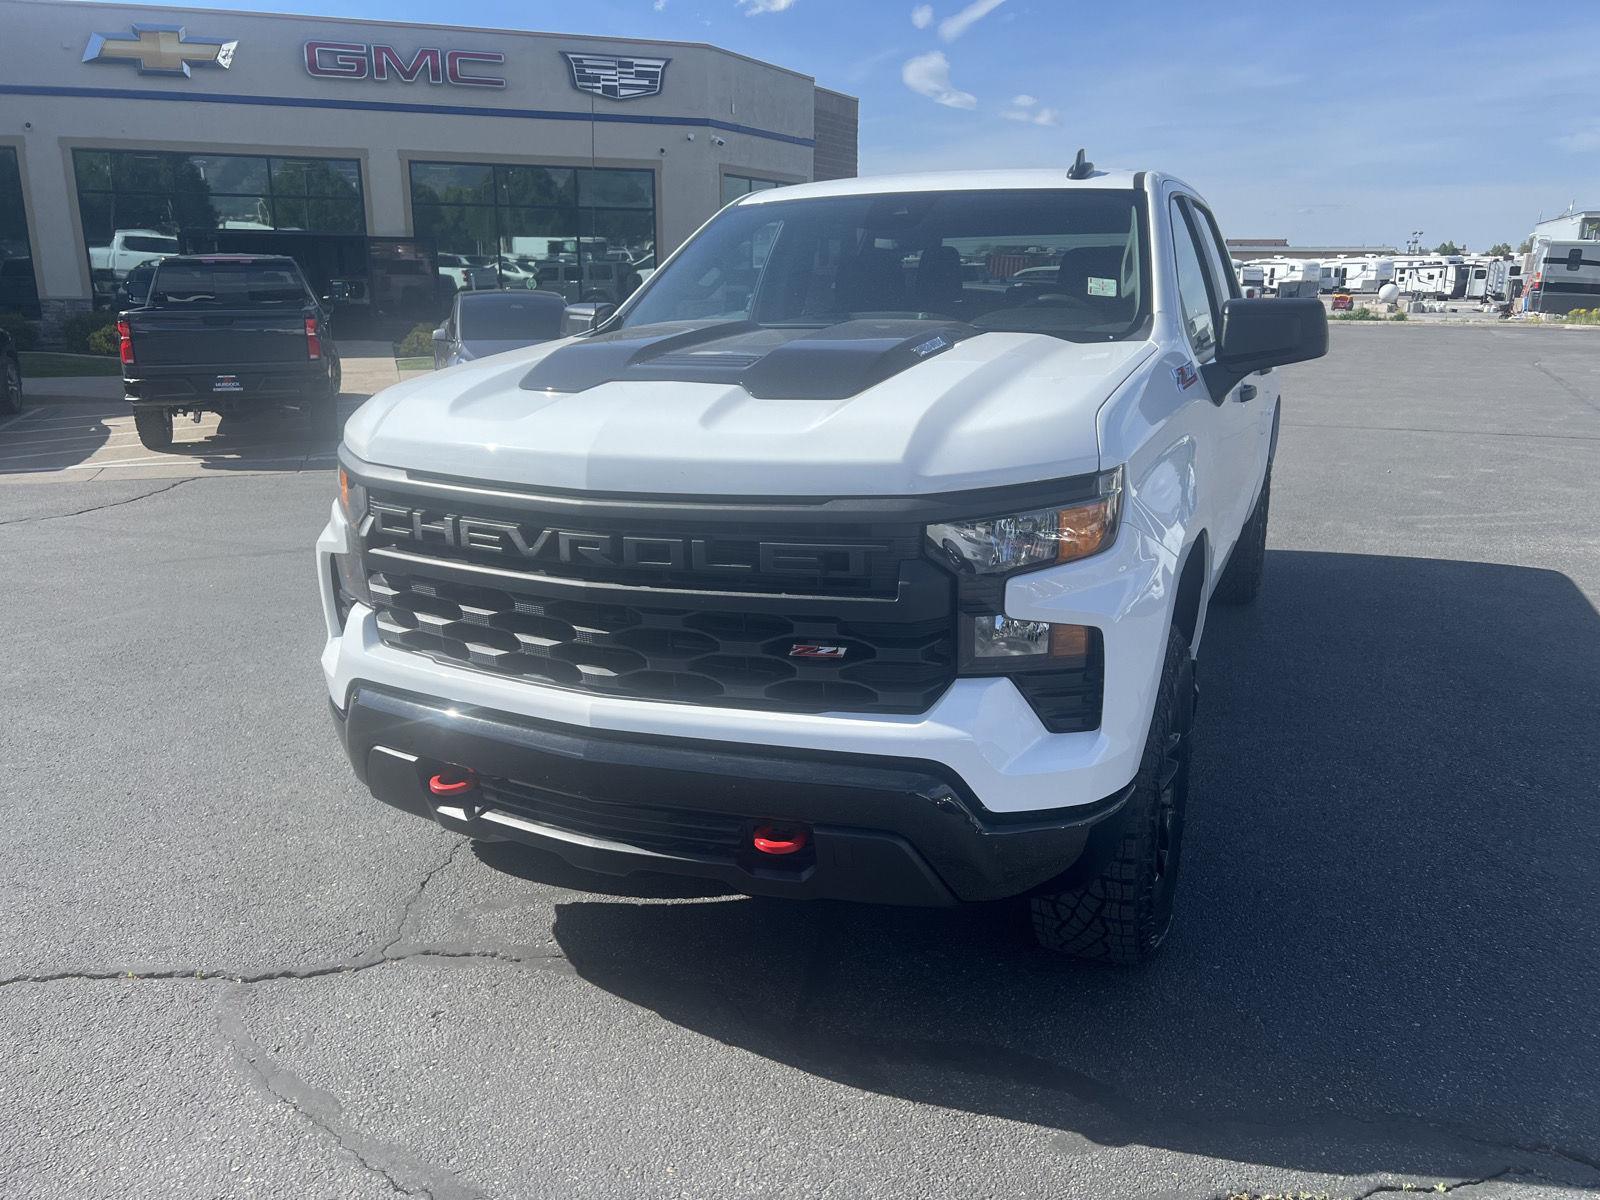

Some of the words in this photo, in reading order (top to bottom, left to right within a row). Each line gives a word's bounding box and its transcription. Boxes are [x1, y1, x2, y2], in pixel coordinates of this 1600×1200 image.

[304, 40, 506, 88] GMC
[371, 501, 890, 577] CHEVROLET
[789, 644, 847, 658] Z71
